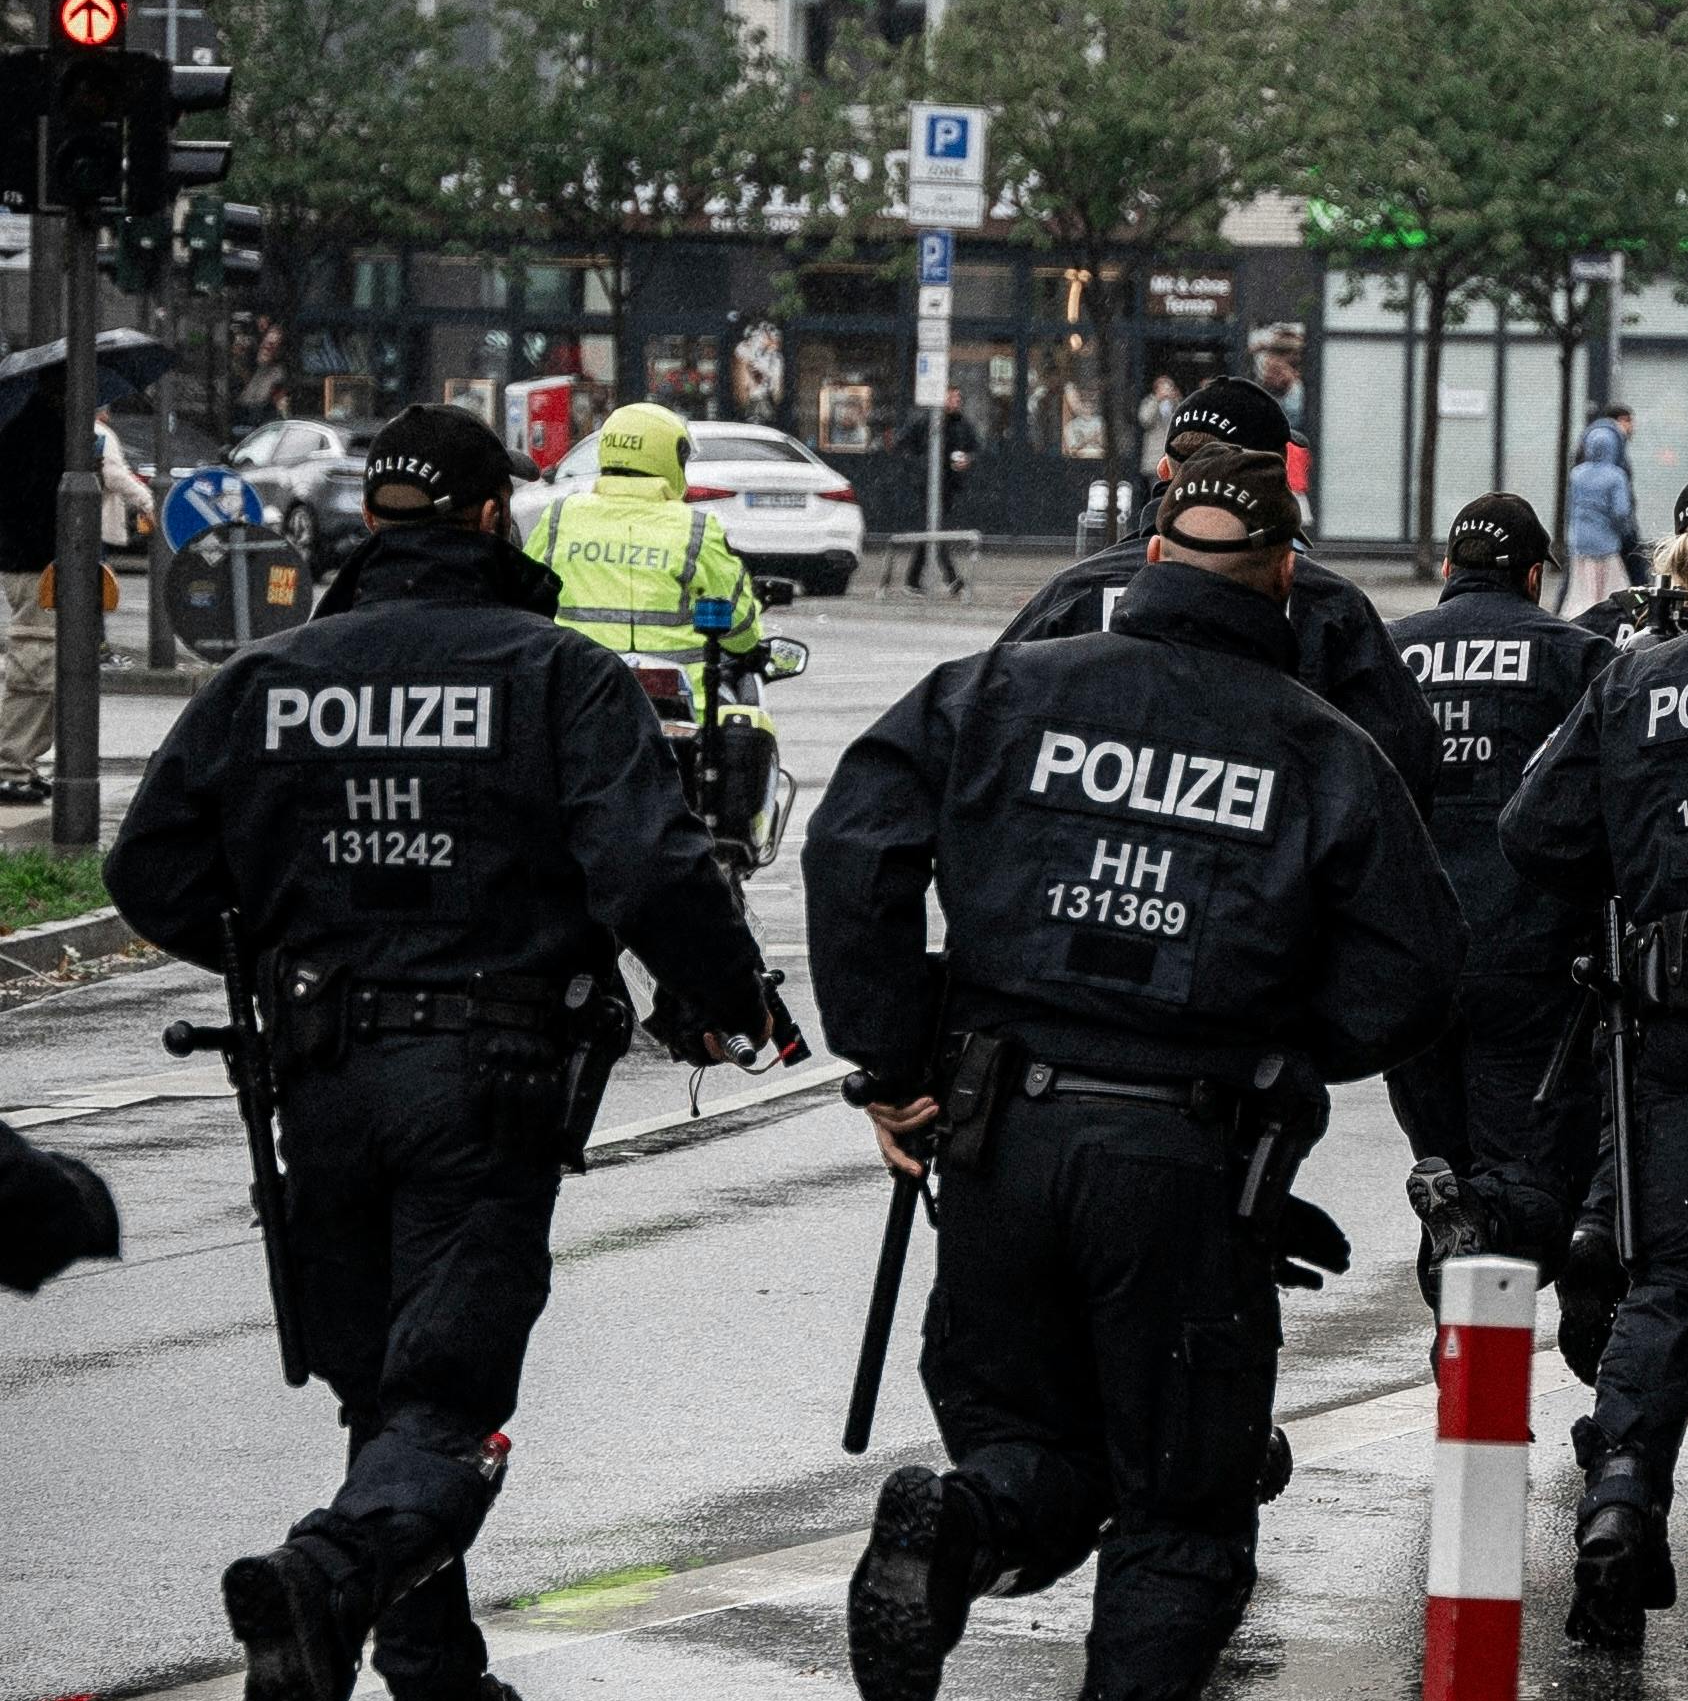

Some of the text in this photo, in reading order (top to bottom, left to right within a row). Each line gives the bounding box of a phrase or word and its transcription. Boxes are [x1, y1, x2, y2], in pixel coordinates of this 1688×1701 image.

[1175, 409, 1237, 435] POLIZEI
[602, 433, 643, 451] POLIZEI
[365, 454, 442, 484] POLIZEI
[1174, 479, 1258, 510] POLIZEI
[1455, 518, 1509, 543] POLIZEI
[568, 538, 670, 571] POLIZEI
[1401, 639, 1531, 684] OLIZEI
[264, 685, 493, 750] POLIZEI
[1442, 735, 1493, 762] 270
[1030, 729, 1277, 833] POLIZEI
[347, 778, 422, 821] HH
[322, 830, 454, 867] 131242
[1090, 838, 1174, 893] HH
[1045, 884, 1188, 937] 131369
